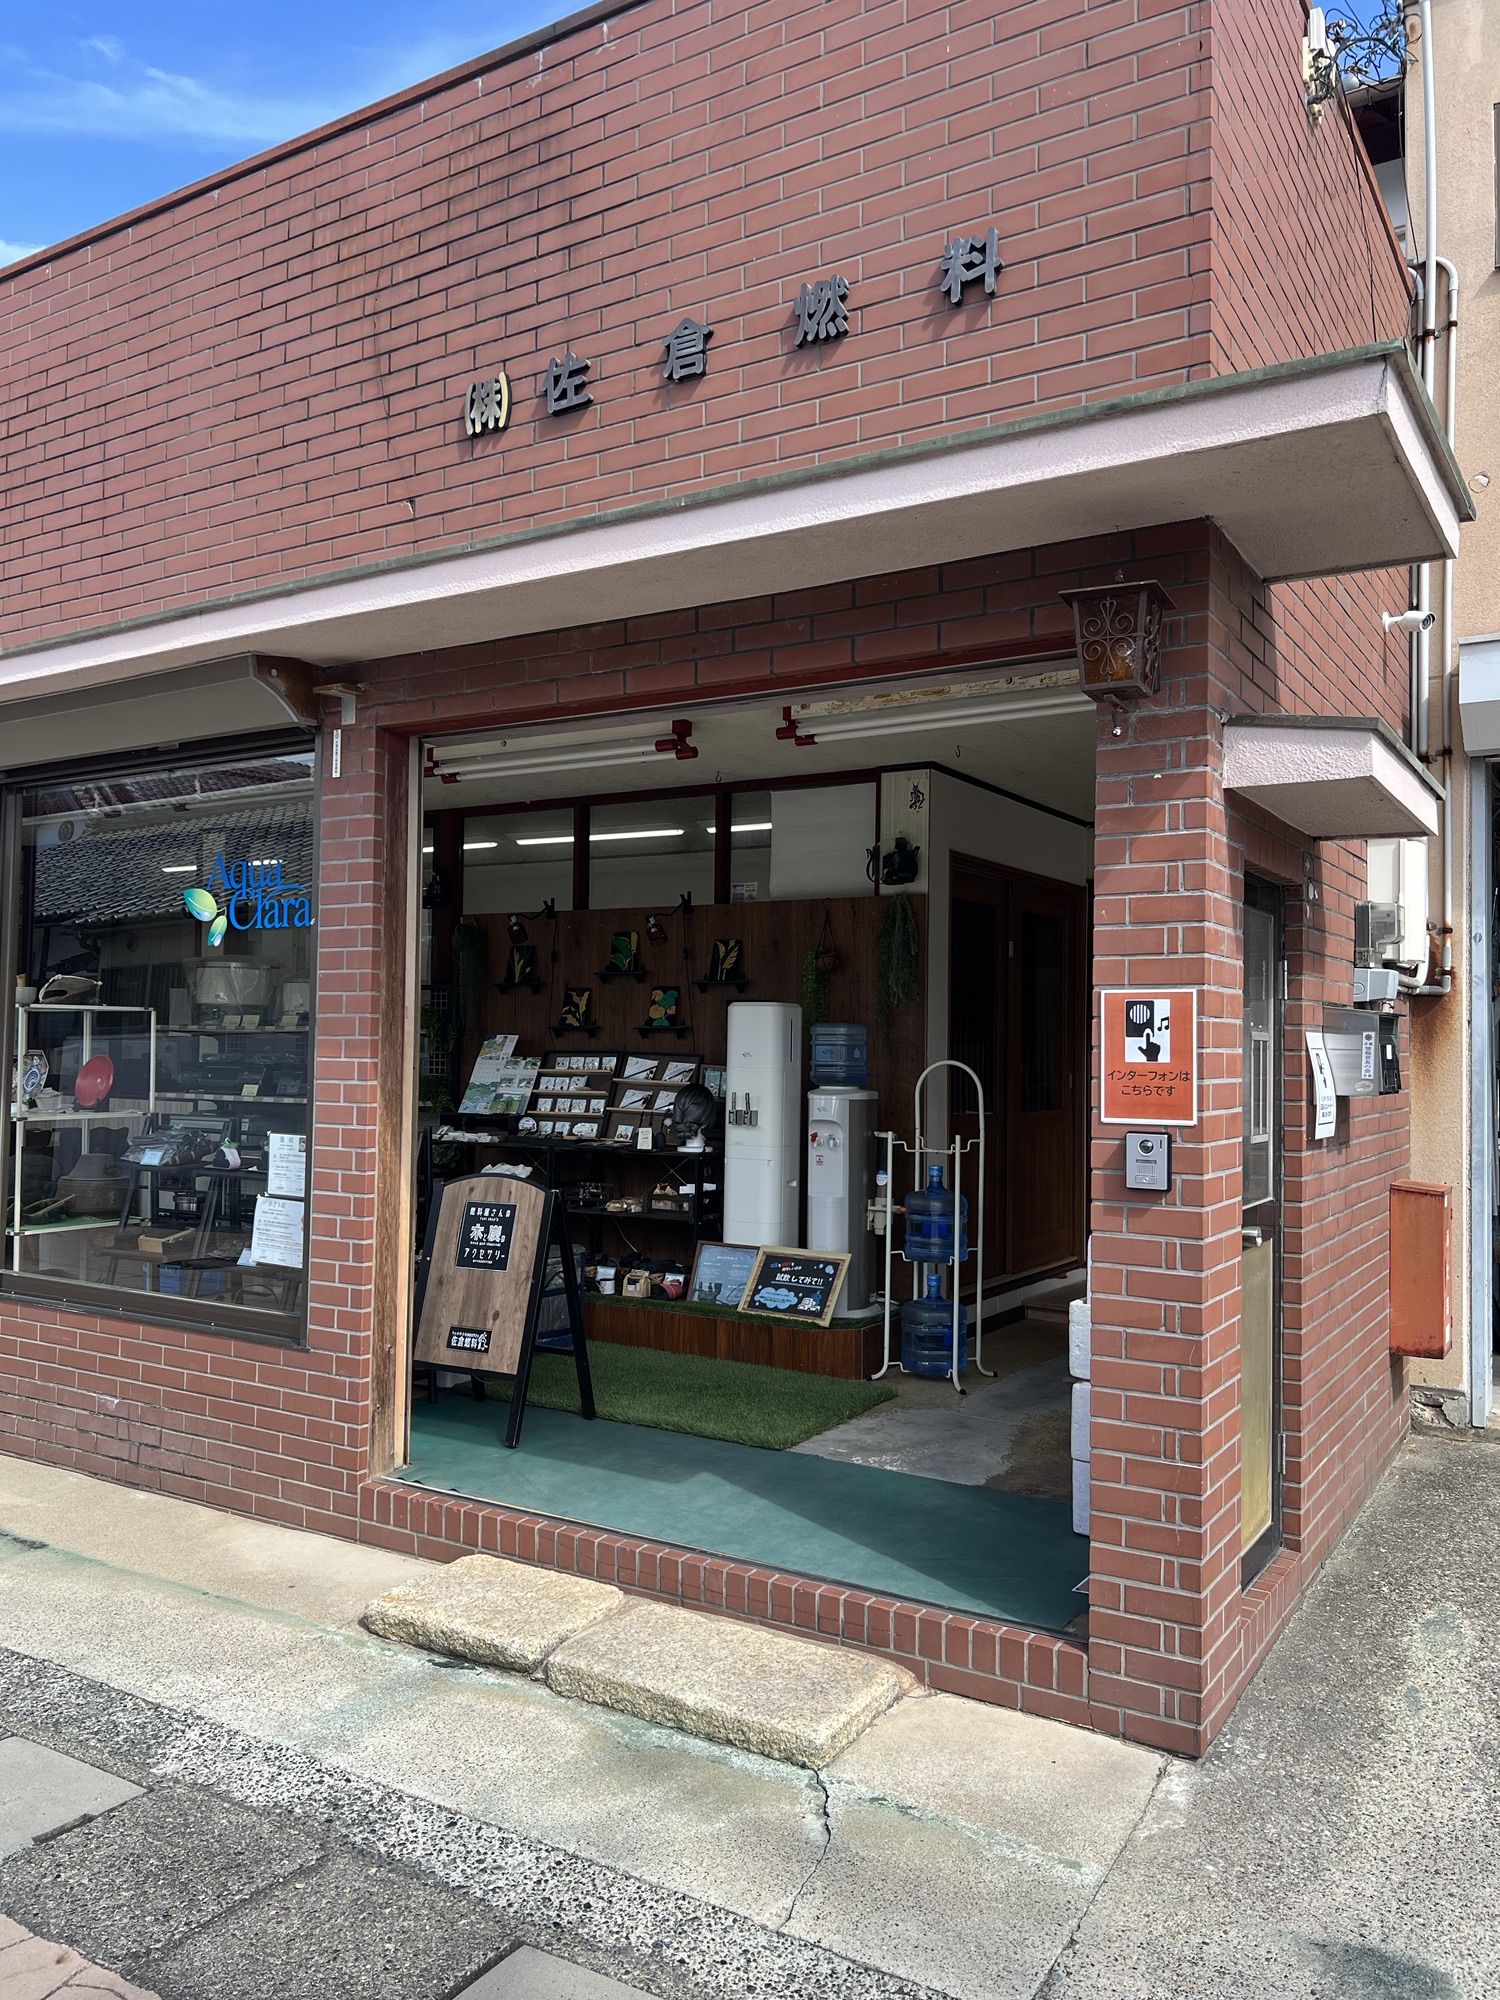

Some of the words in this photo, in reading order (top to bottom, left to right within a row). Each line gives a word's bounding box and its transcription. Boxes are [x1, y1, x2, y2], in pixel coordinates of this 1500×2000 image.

[205, 850, 286, 900] Aqua
[228, 885, 312, 931] Clara
[1107, 1069, 1191, 1083] インターフォンは
[1121, 1084, 1176, 1097] こちらです
[464, 1247, 506, 1260] アクセサリー
[775, 1272, 824, 1286] 試飲してみて!!
